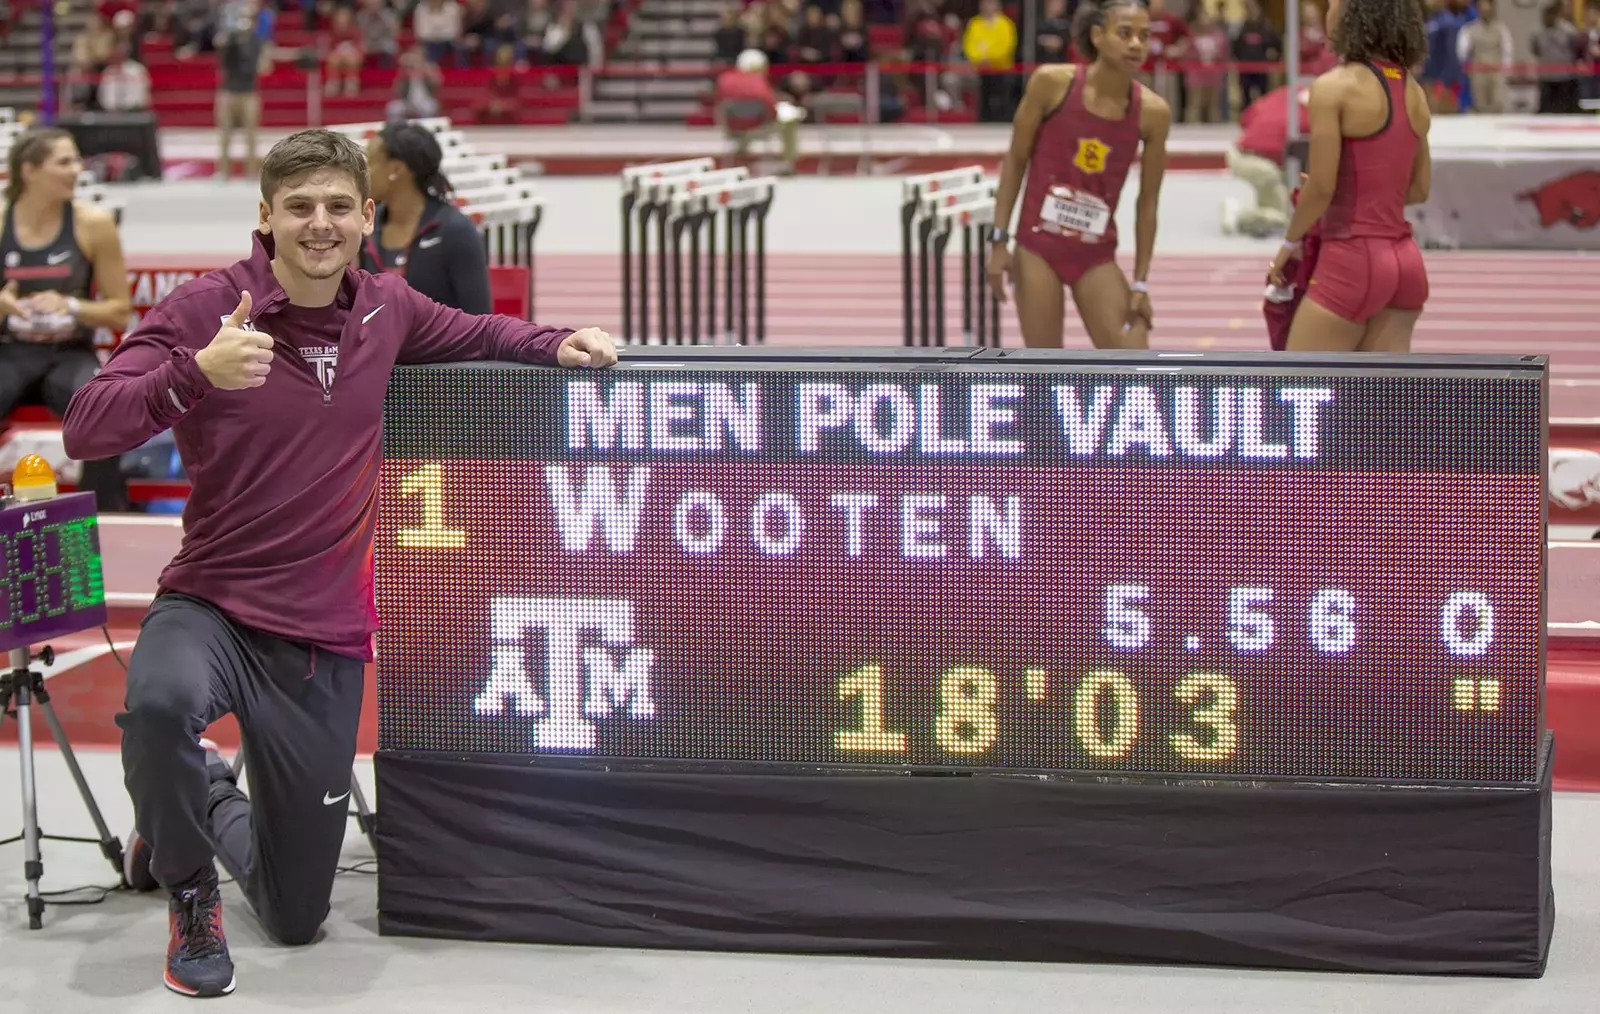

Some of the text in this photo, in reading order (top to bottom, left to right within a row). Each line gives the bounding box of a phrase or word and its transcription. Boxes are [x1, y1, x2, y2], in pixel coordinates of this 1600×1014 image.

[298, 346, 323, 355] TEXAS
[567, 381, 1333, 458] MEN POLE VAULT
[397, 464, 466, 548] 1
